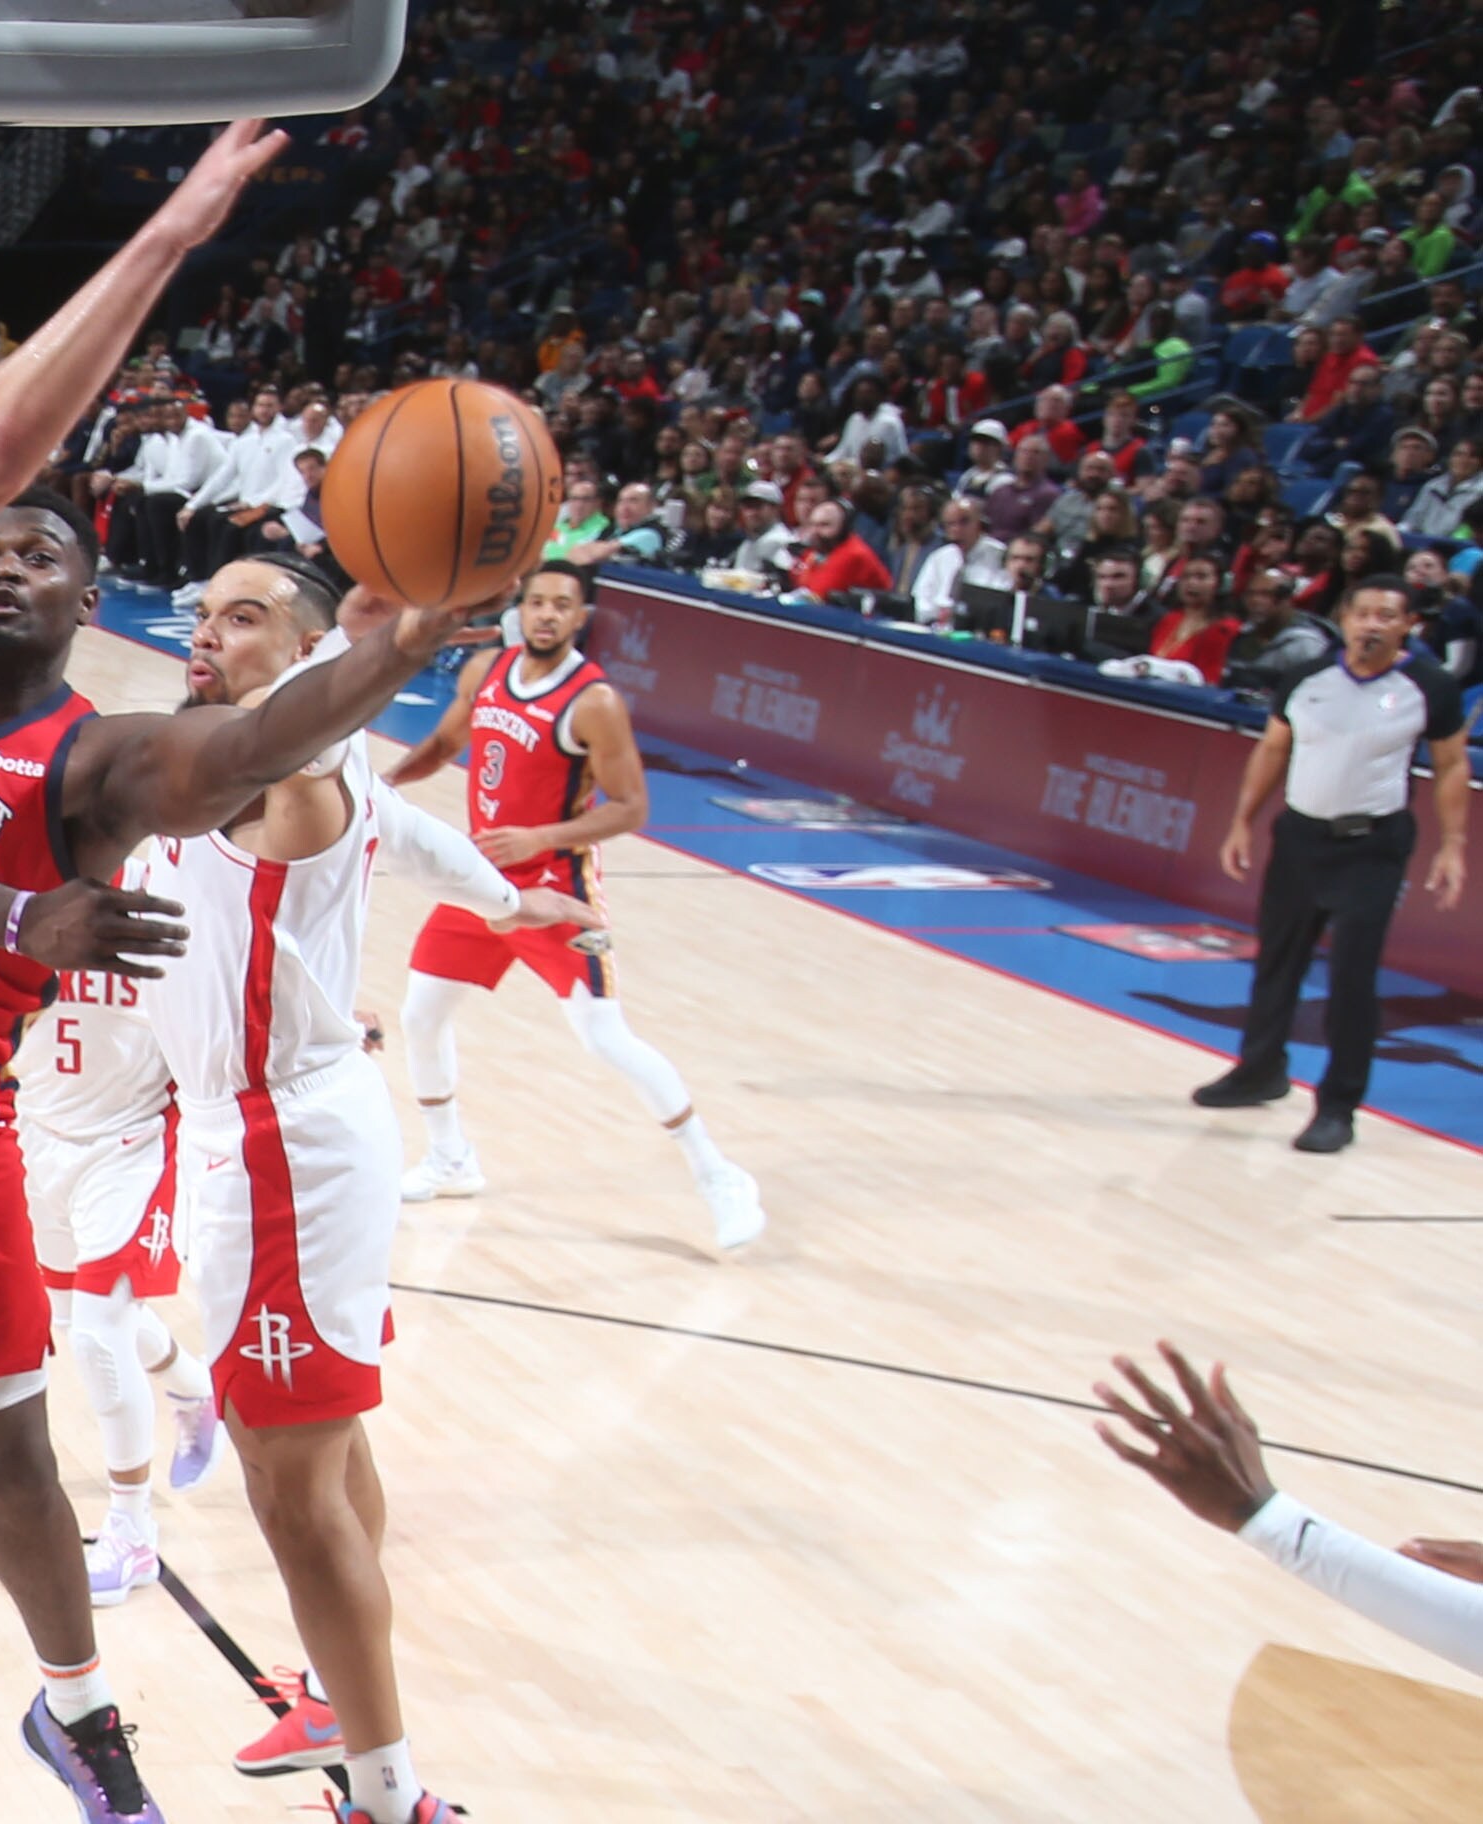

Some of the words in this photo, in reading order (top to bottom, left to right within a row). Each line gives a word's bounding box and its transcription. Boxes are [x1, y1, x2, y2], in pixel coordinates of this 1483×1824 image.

[479, 740, 506, 790] 3
[1085, 776, 1197, 854] BLENDER
[57, 968, 138, 1008] KETS
[56, 1018, 82, 1074] 5
